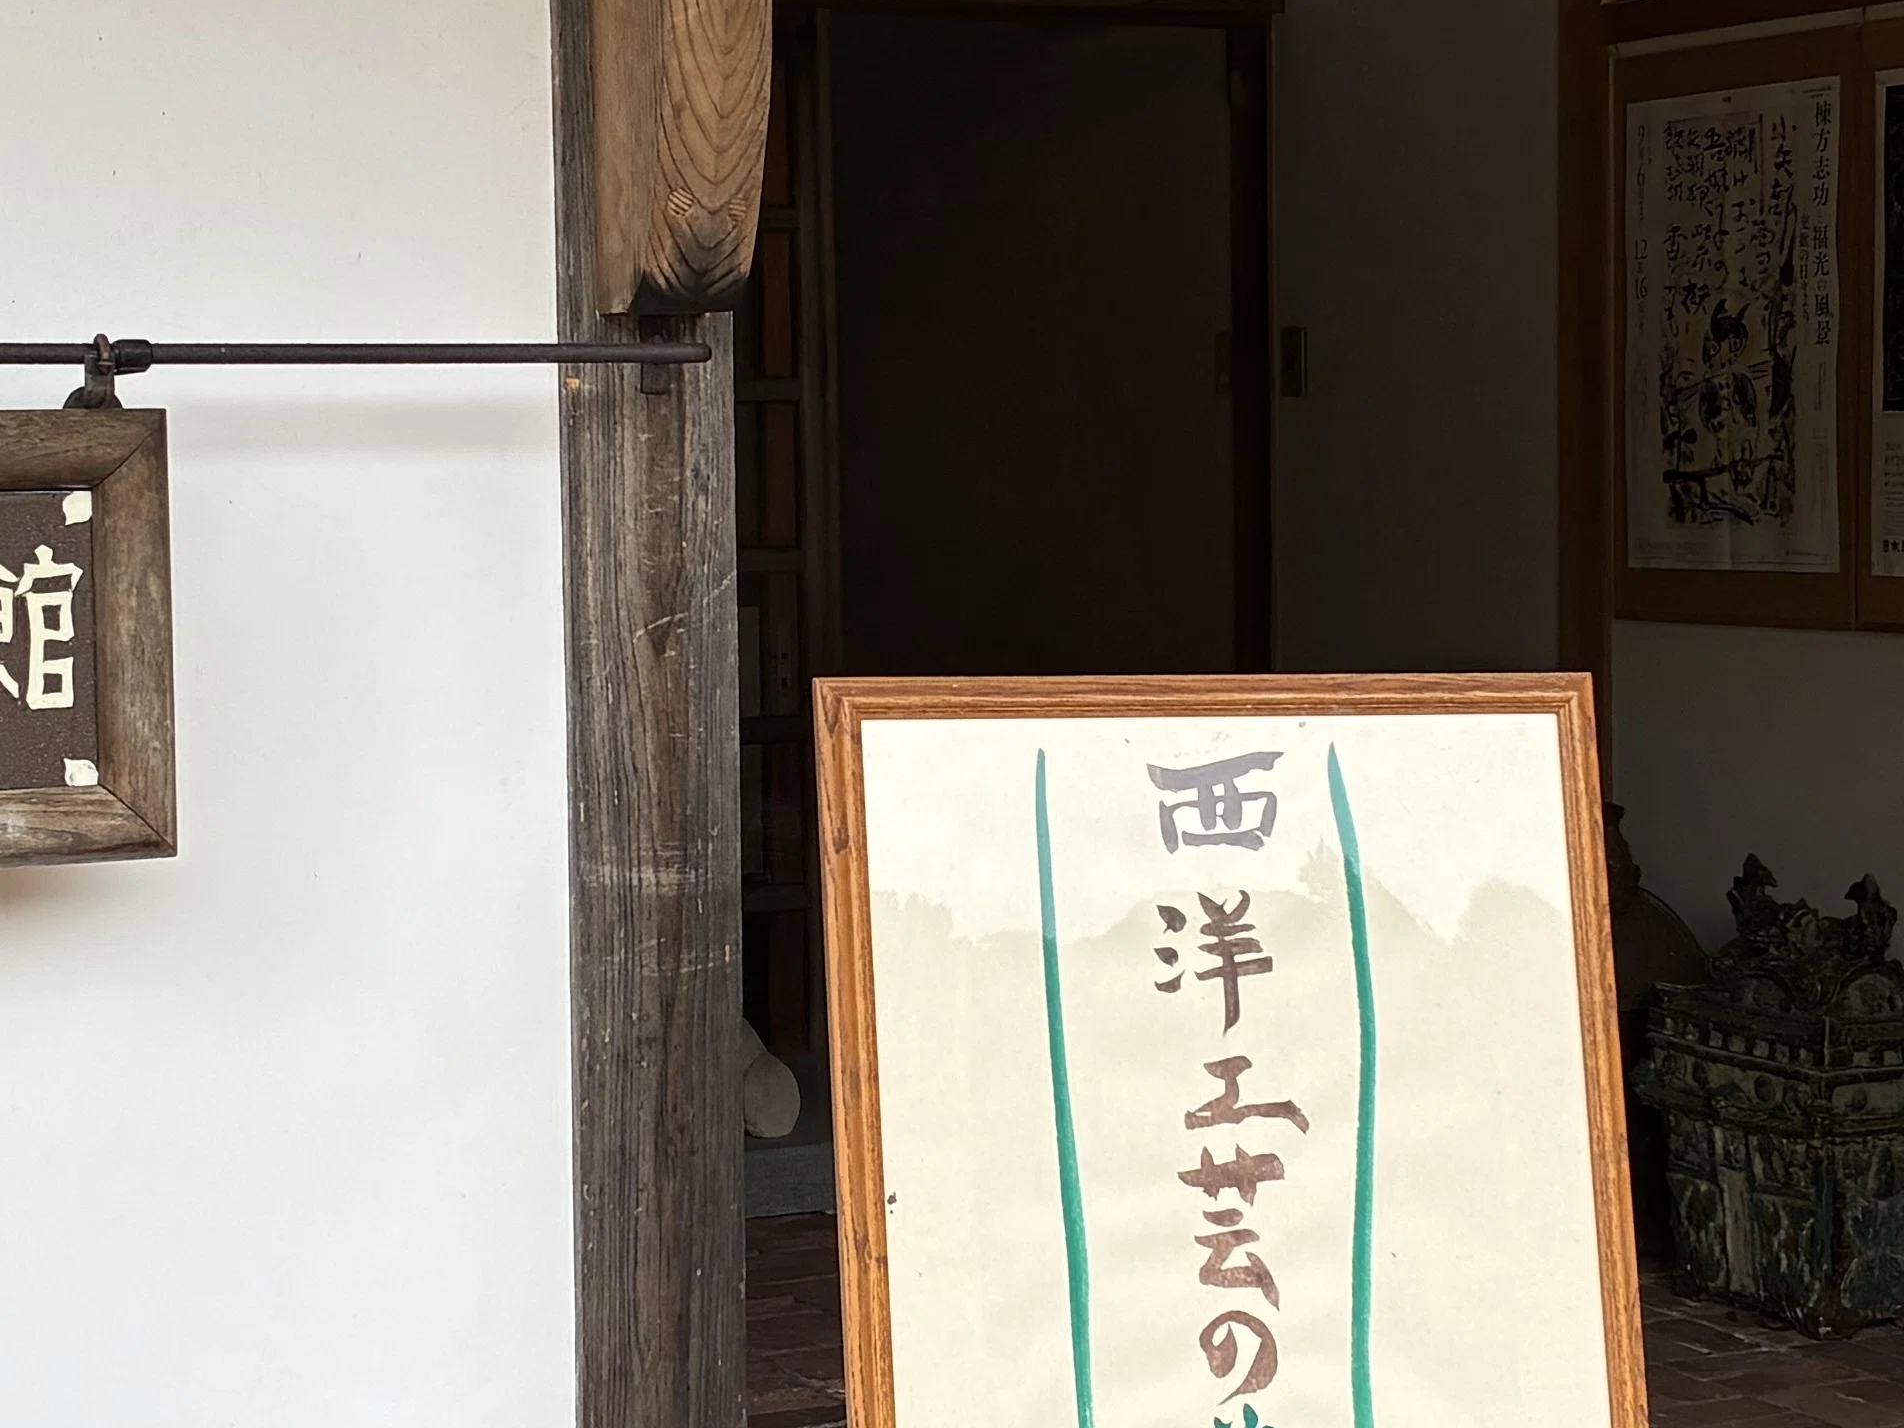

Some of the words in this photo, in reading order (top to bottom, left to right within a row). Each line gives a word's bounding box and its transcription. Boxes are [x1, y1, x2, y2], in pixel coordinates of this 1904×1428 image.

[1811, 100, 1832, 345] 棟方志功福光の風景
